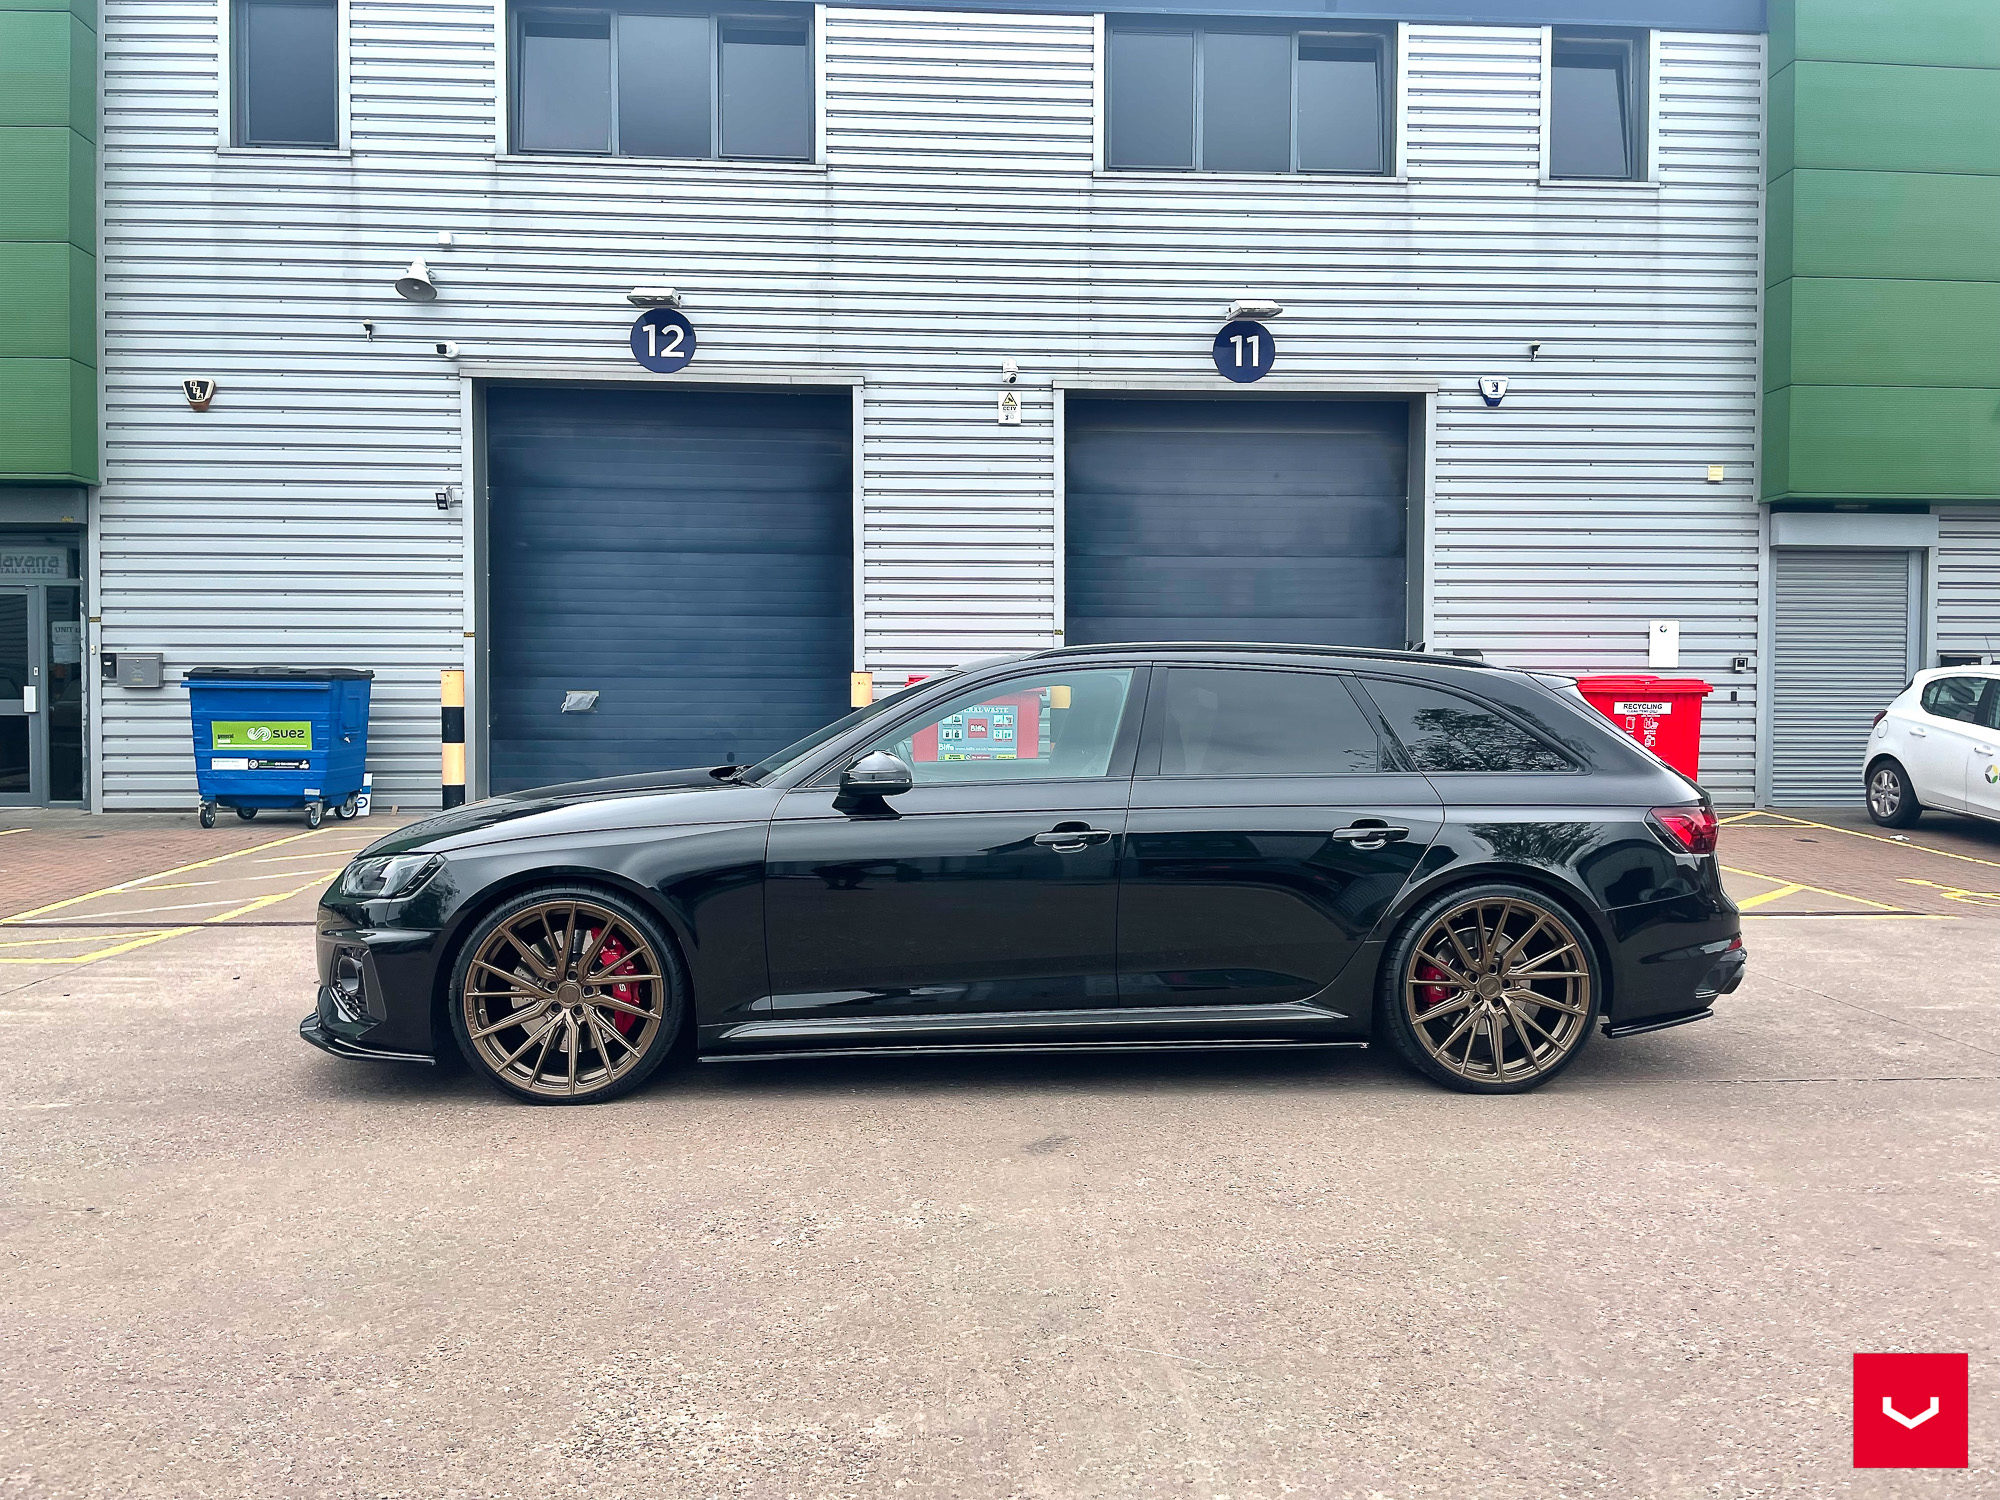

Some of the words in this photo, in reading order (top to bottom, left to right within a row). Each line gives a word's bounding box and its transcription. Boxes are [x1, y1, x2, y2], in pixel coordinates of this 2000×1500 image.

[642, 324, 685, 358] 12
[1229, 335, 1260, 367] 11
[0, 554, 59, 568] avarra
[273, 729, 305, 738] suez
